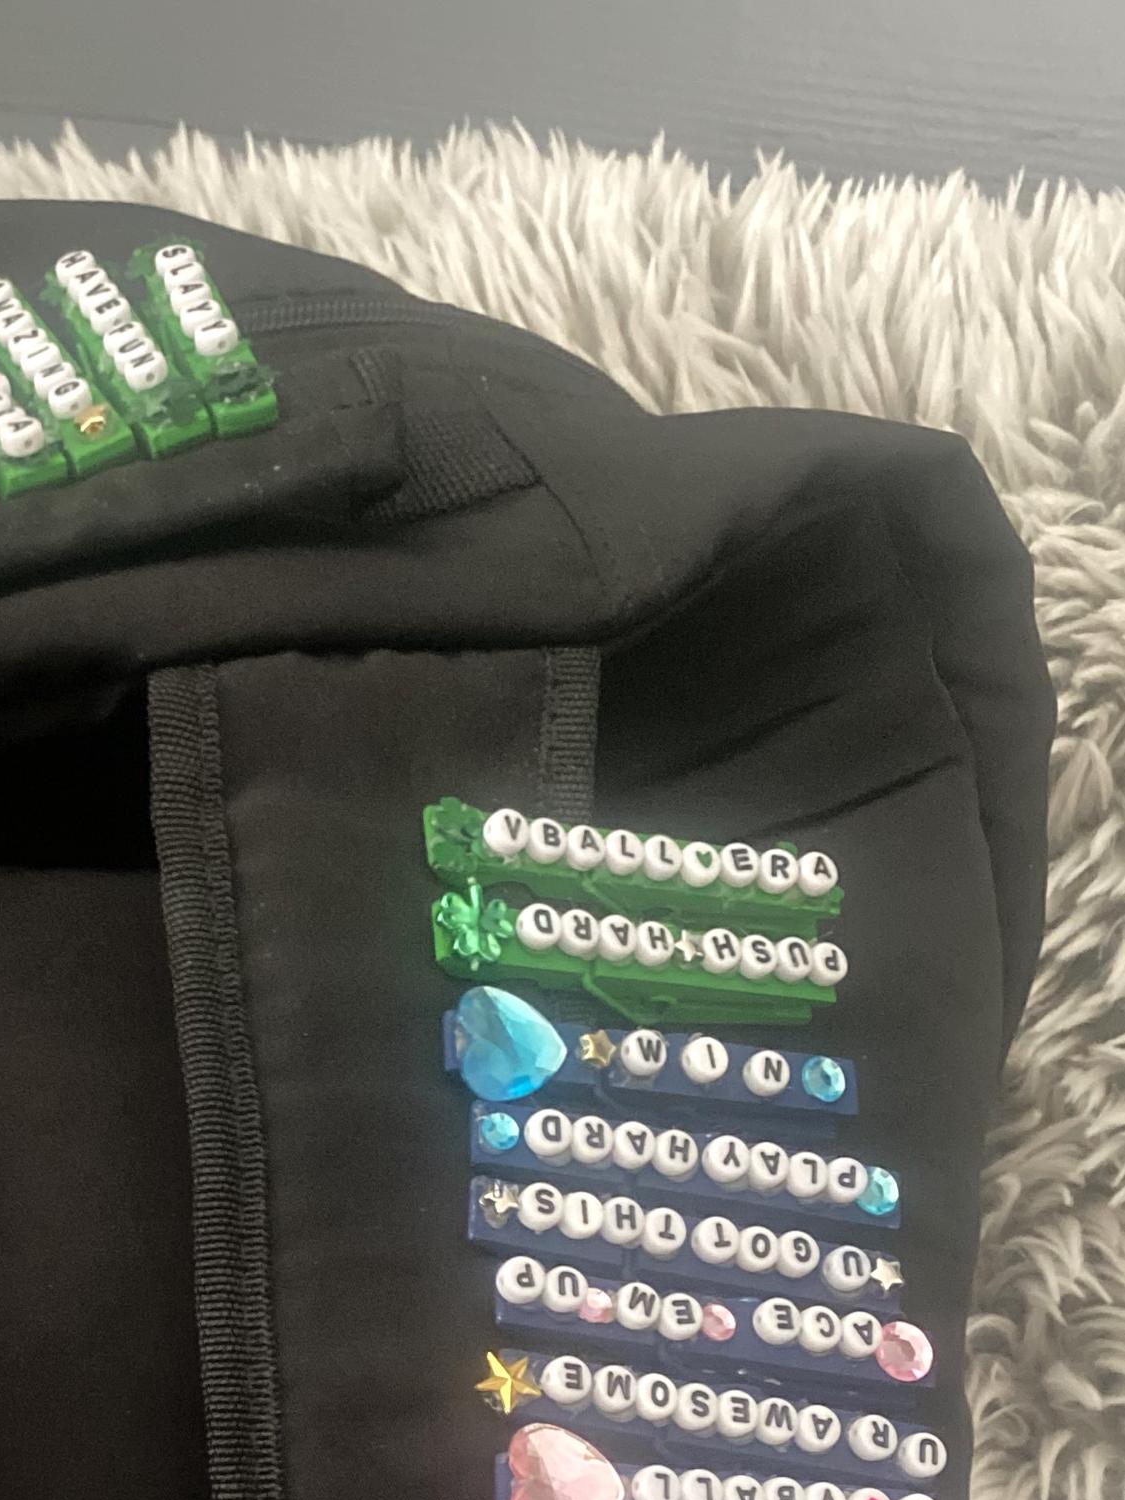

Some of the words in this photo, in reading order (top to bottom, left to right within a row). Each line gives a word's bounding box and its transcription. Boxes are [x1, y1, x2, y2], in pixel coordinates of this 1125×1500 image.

[60, 252, 122, 316] HAVE
[162, 246, 228, 333] SLAYY
[504, 815, 675, 865] VBALL
[730, 849, 832, 878] ERA
[532, 910, 670, 951] HARD
[711, 934, 841, 972] PUSH
[637, 1036, 784, 1083] WIN
[540, 1115, 691, 1159] HARD
[721, 1143, 858, 1188] PLAY
[535, 1188, 676, 1241] THIS
[713, 1222, 812, 1264] GOT
[514, 1263, 580, 1298] UP
[627, 1285, 696, 1326] EM
[775, 1303, 876, 1347] ACE
[562, 1362, 834, 1440] AWESOME
